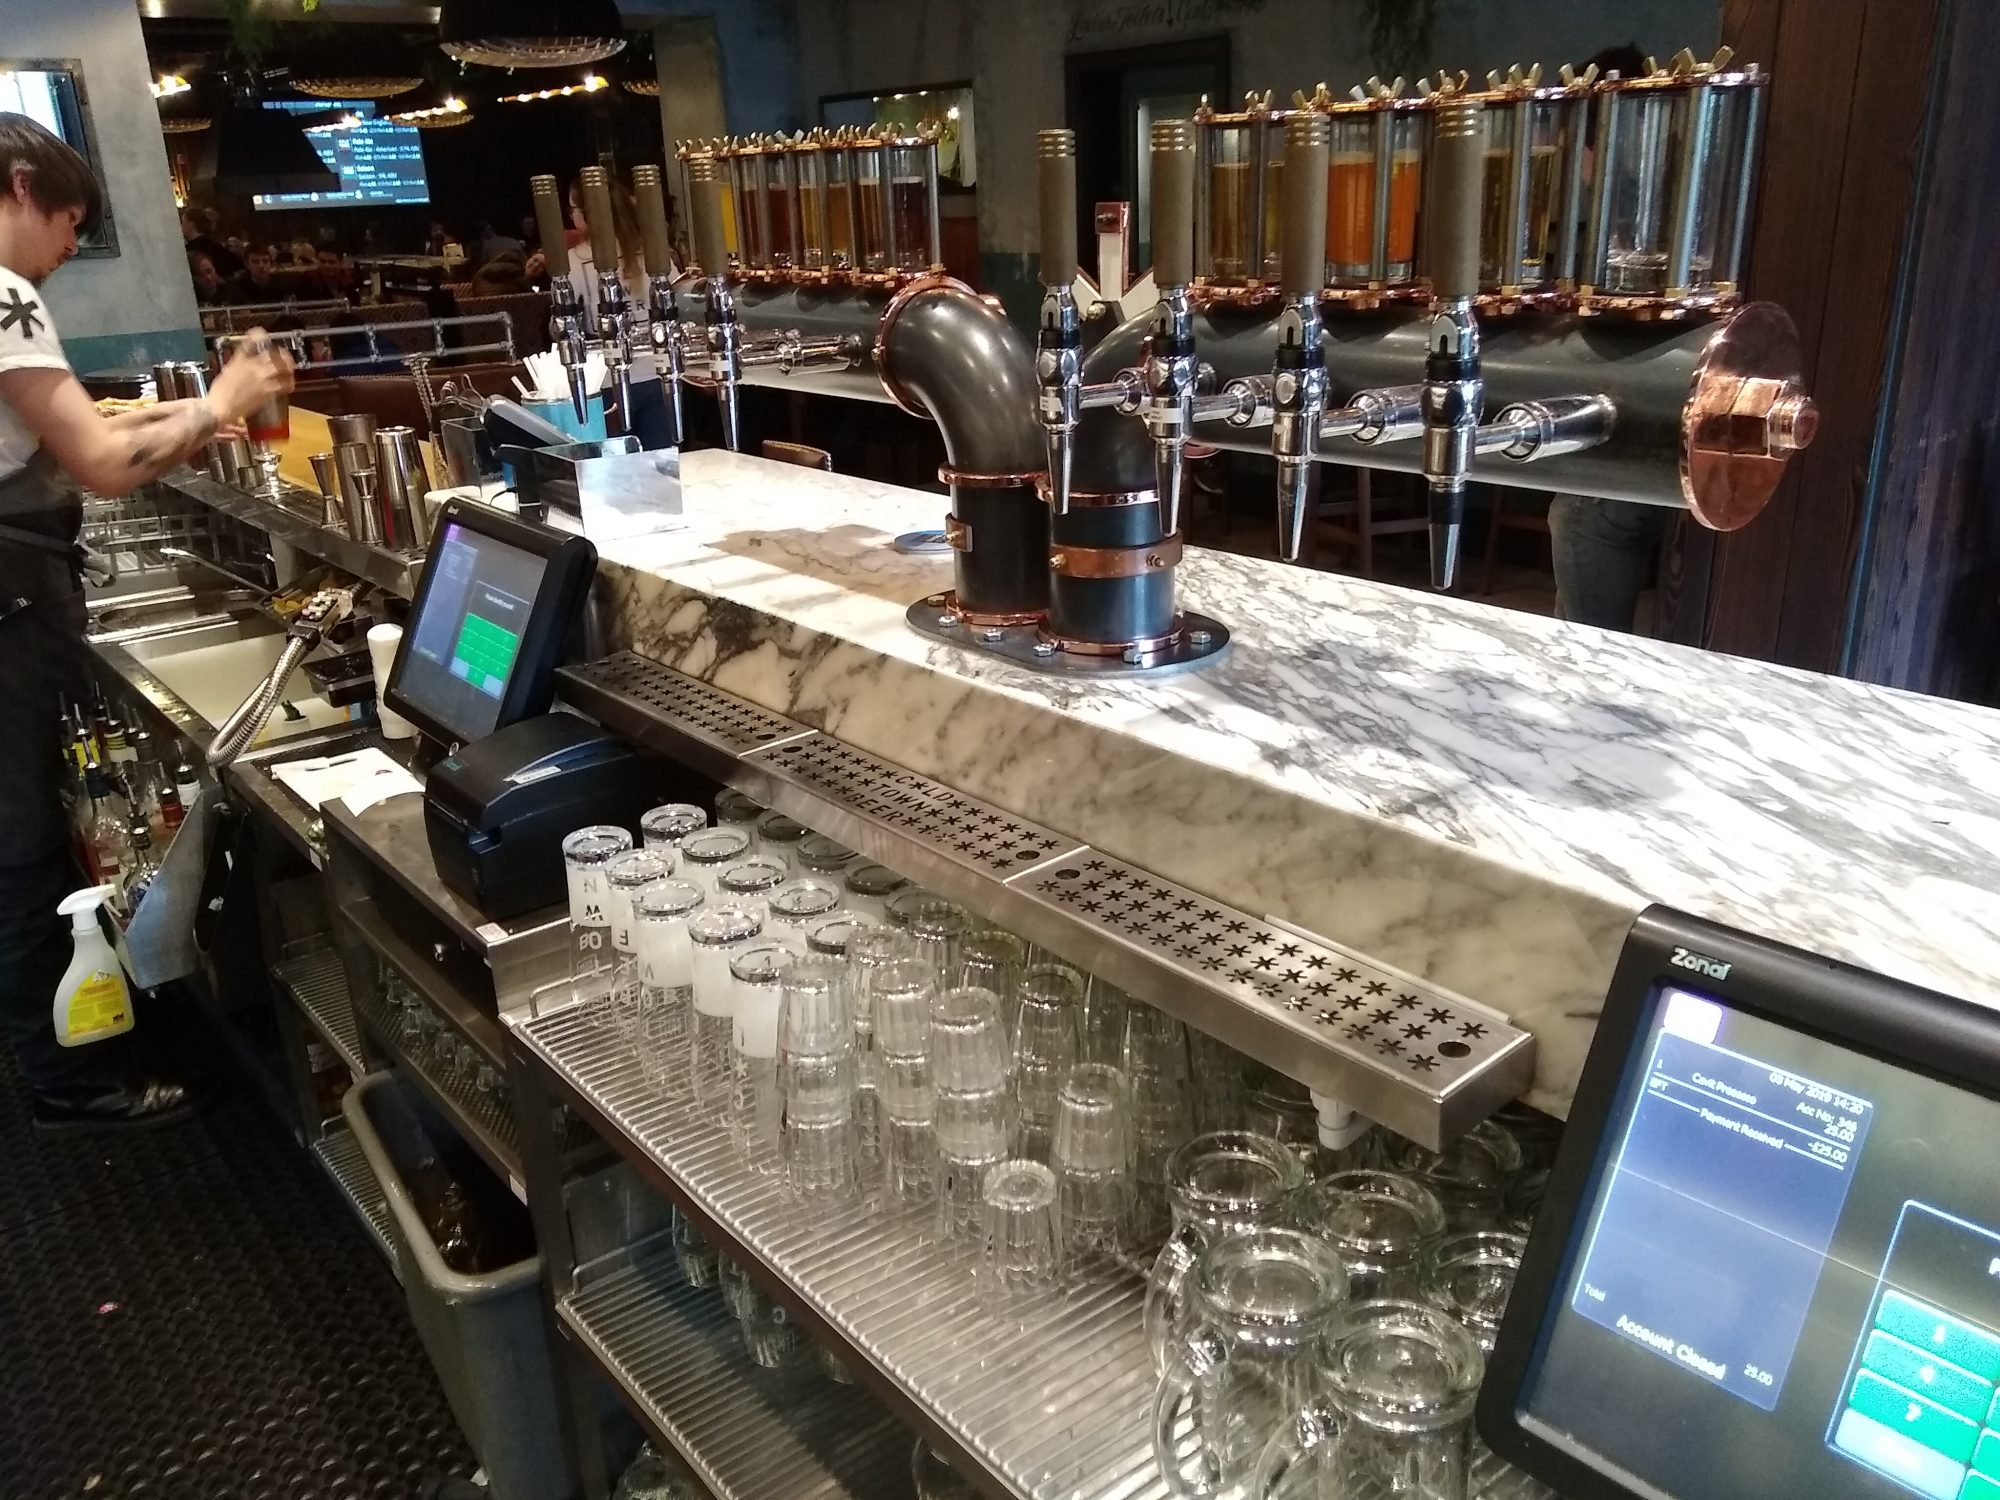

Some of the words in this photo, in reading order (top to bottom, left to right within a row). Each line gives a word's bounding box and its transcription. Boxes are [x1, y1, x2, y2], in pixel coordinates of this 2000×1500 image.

[844, 793, 904, 821] BEER
[870, 783, 932, 812] TOWN
[1671, 947, 1732, 981] Zonal
[1783, 1076, 1804, 1094] May
[1806, 1084, 1833, 1102] 2019
[1833, 1094, 1864, 1115] 14:20
[1796, 1102, 1815, 1117] Acc
[1700, 1107, 1740, 1133] Payment
[1740, 1122, 1784, 1150] Received
[1584, 1283, 1606, 1302] Total
[1616, 1314, 1675, 1355] Account
[1676, 1343, 1727, 1380] Closed
